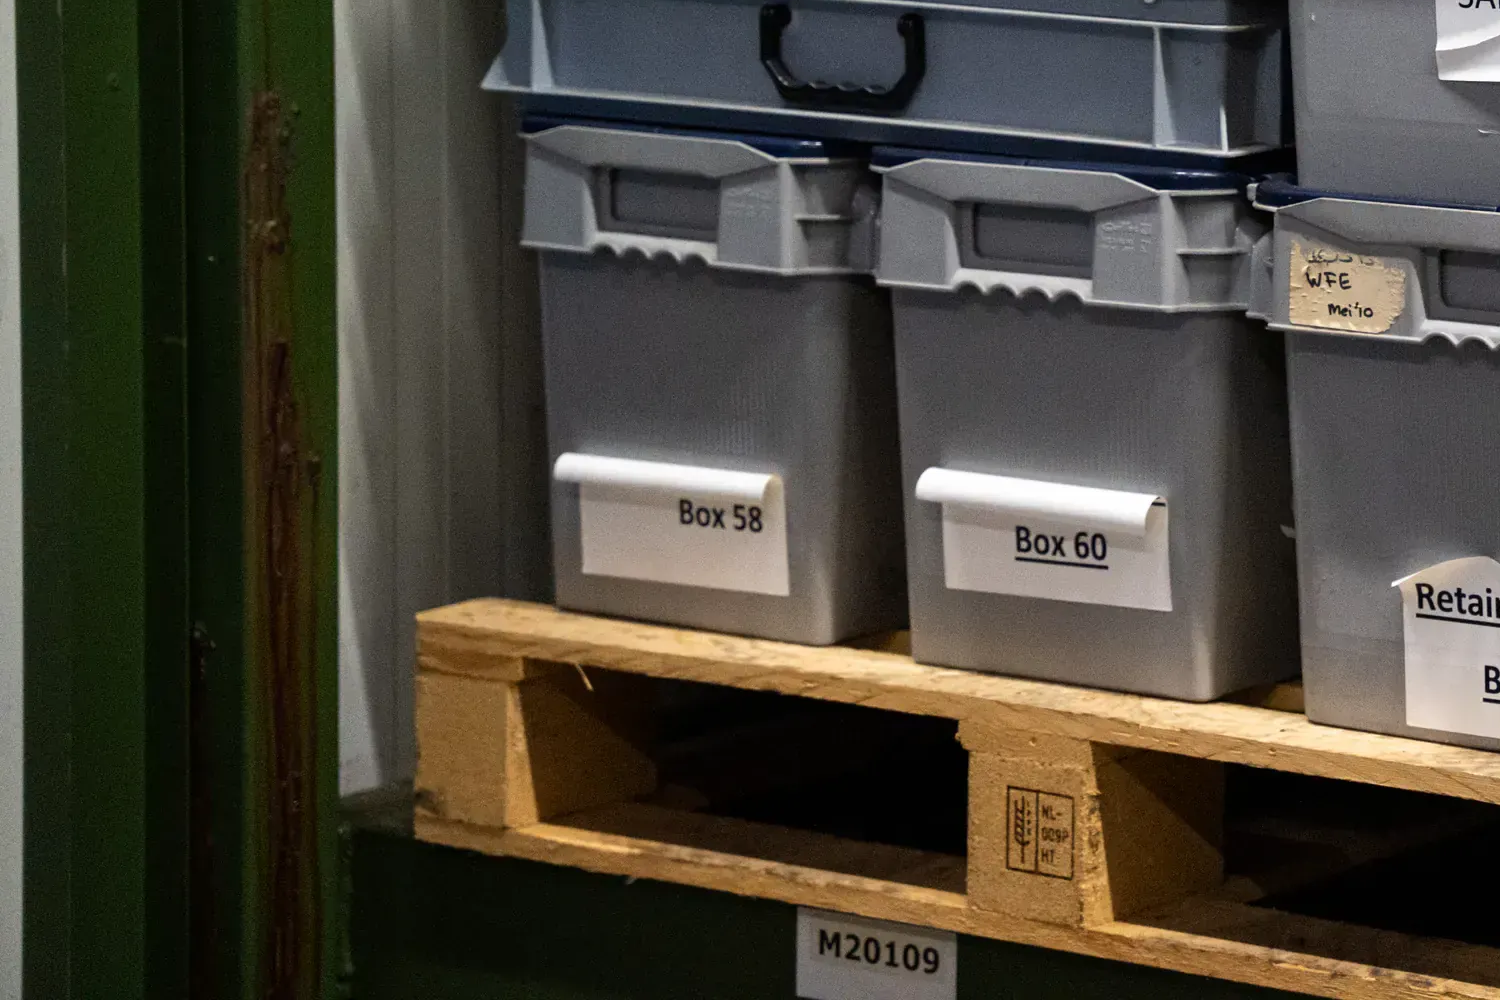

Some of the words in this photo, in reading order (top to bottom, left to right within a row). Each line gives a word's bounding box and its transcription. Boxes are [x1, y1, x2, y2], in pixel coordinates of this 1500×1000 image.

[1305, 271, 1352, 290] WFE
[678, 499, 726, 529] Box
[733, 503, 763, 533] 58
[1015, 525, 1066, 557] Box
[1074, 531, 1107, 561] 60
[819, 929, 939, 974] M20109
